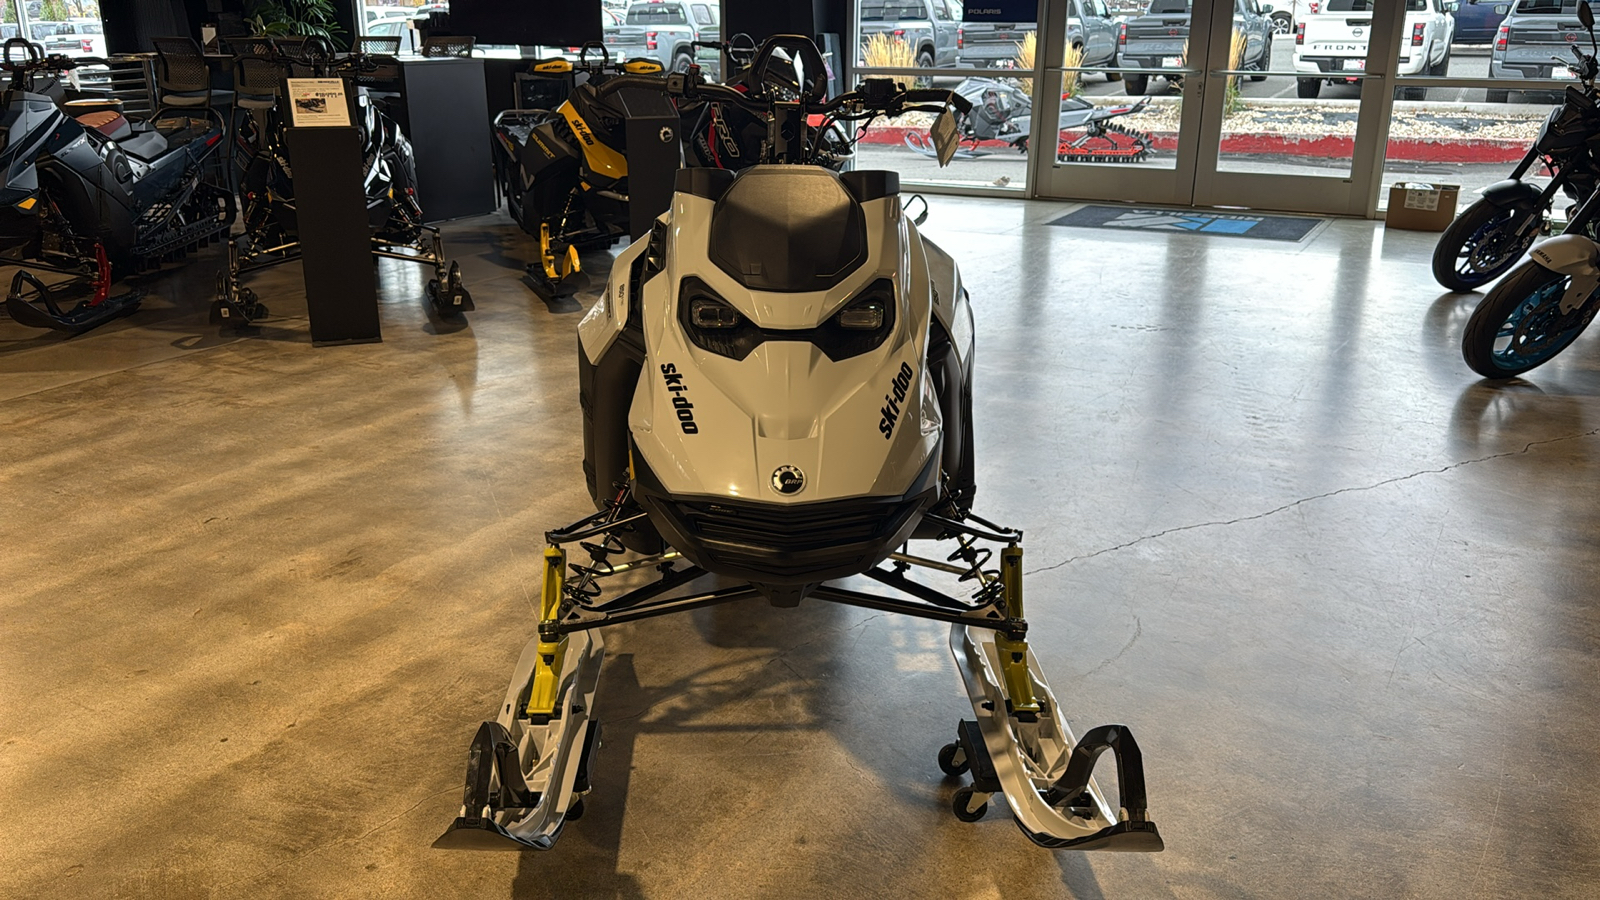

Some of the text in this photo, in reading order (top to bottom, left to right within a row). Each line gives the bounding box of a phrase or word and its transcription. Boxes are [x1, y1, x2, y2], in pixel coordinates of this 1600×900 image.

[531, 132, 556, 158] SUMMIT
[571, 119, 594, 146] ski-doo
[710, 101, 741, 158] PRO
[660, 363, 698, 434] ski-doo
[879, 361, 913, 440] ski-doo
